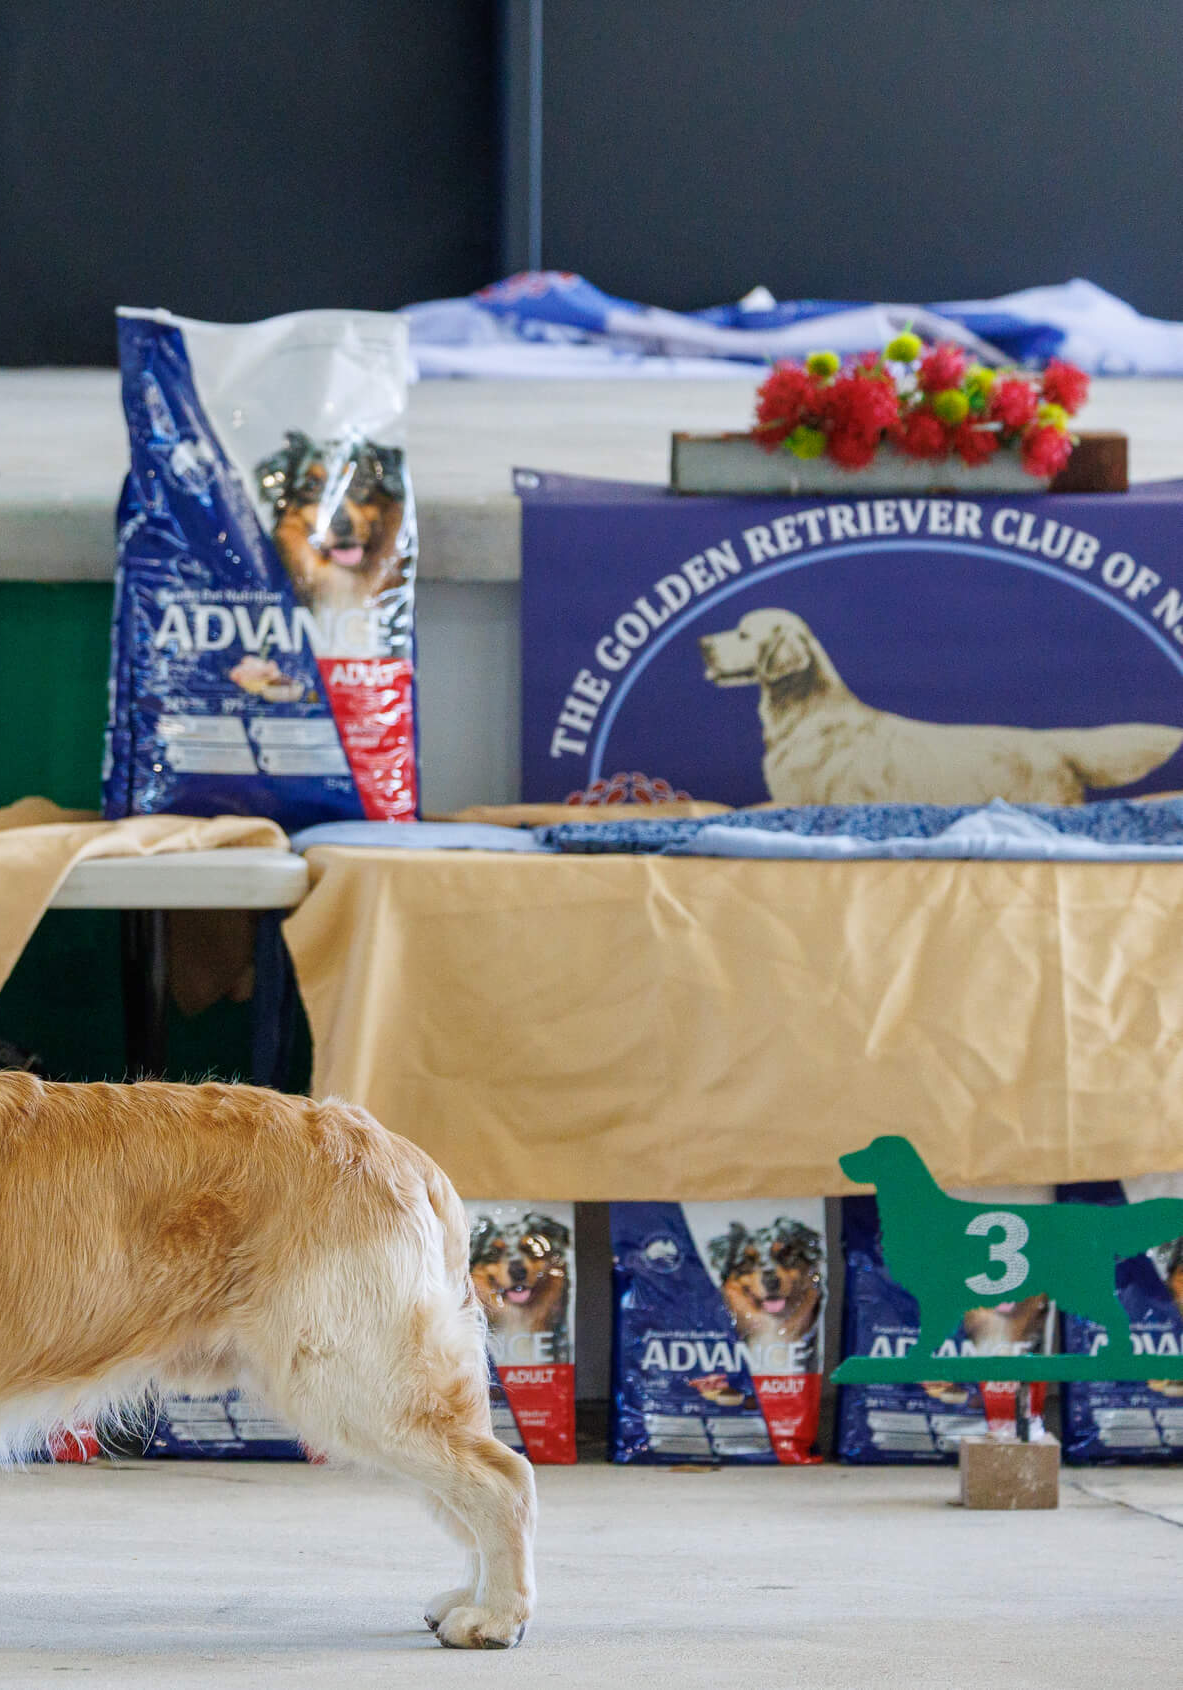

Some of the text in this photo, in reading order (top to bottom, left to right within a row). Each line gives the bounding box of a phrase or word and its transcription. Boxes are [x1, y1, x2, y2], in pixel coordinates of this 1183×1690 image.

[154, 604, 393, 657] ADVANCE
[550, 668, 612, 760] THE
[594, 539, 744, 674] GOLDEN
[741, 498, 984, 565] RETRIEVER
[990, 509, 1102, 571] CLUB
[1101, 551, 1163, 601] OF
[964, 1210, 1030, 1296] 3
[505, 1368, 556, 1384] ADULT
[641, 1340, 808, 1373] ADVANCE
[760, 1379, 806, 1394] ADULT
